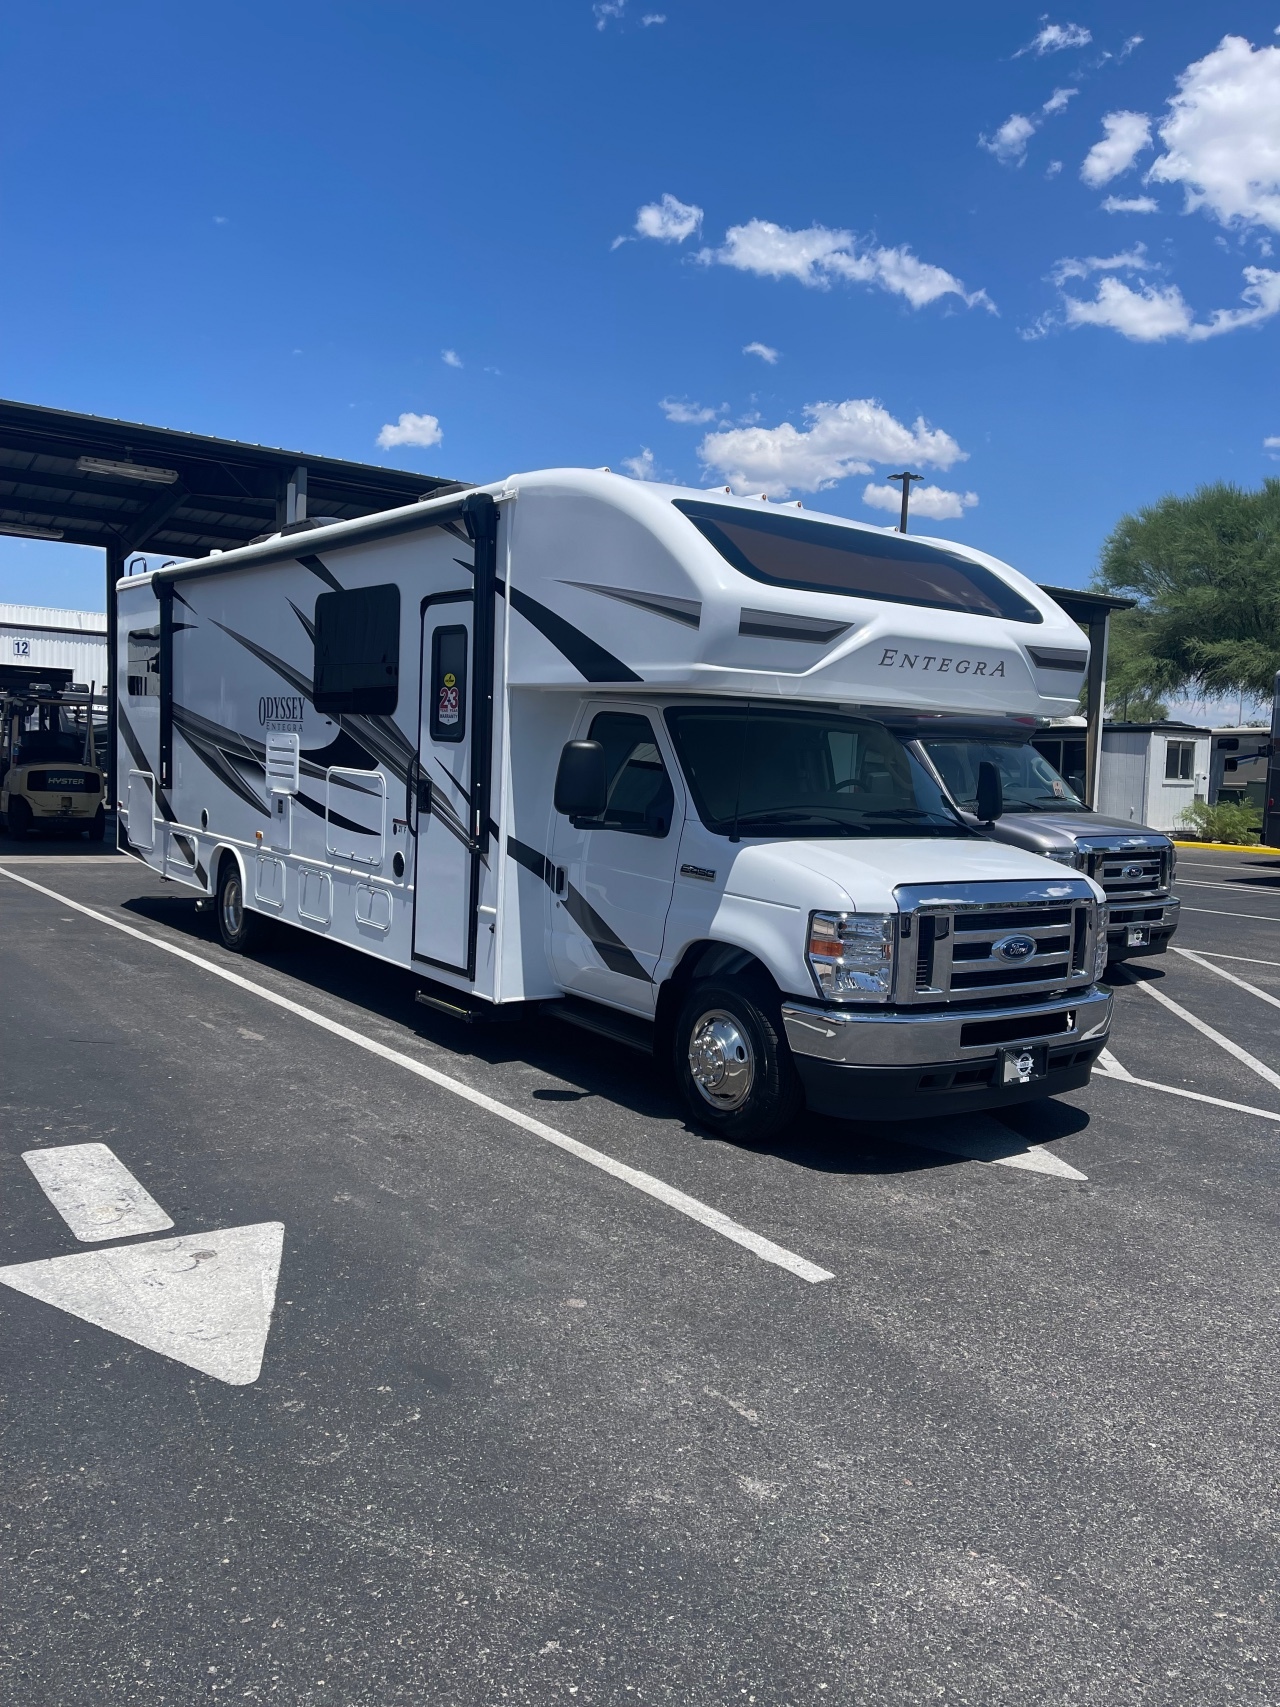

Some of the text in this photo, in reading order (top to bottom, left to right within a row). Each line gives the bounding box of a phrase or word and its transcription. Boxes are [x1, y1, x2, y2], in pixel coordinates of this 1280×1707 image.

[15, 642, 28, 654] 12
[878, 648, 1006, 678] ENTEGRA
[258, 696, 306, 726] ODYSSEY
[266, 721, 304, 733] ENTEGRA
[47, 777, 85, 785] HYSTER
[1009, 942, 1029, 955] Ford
